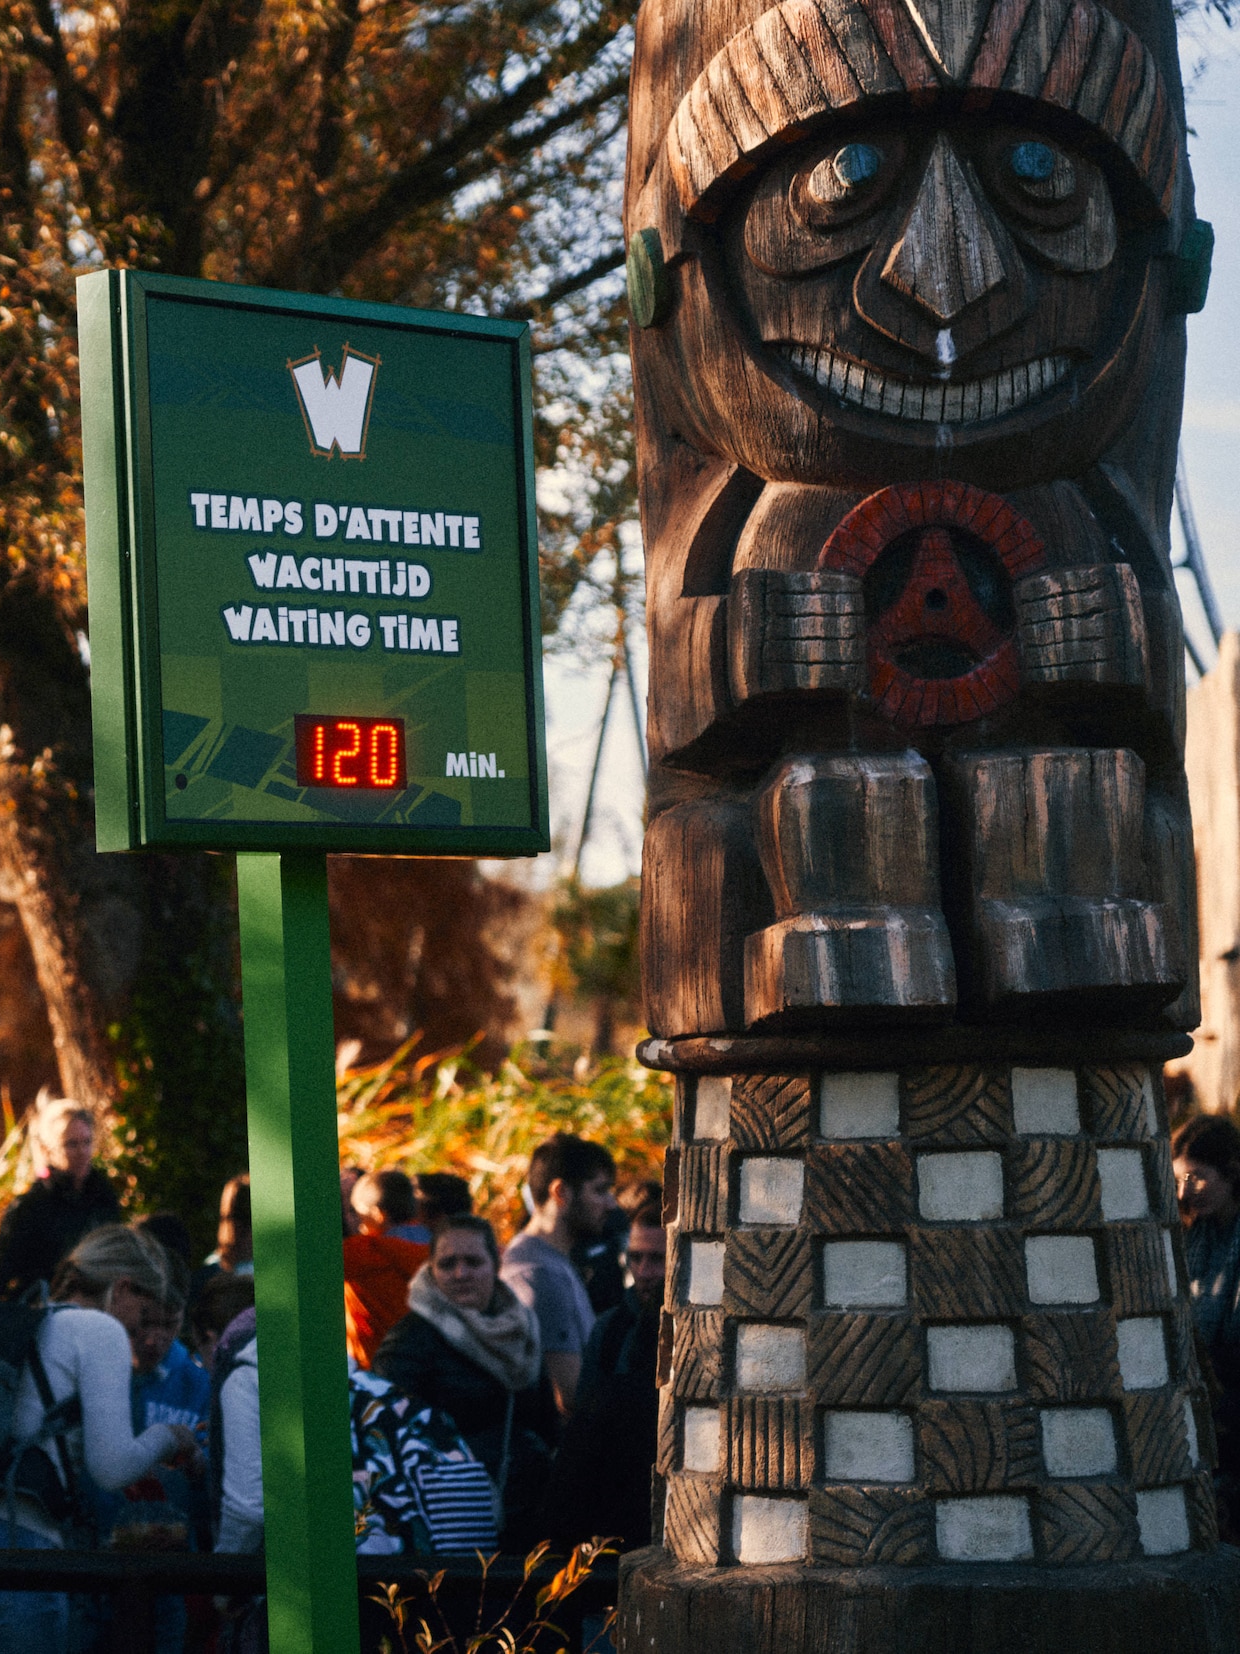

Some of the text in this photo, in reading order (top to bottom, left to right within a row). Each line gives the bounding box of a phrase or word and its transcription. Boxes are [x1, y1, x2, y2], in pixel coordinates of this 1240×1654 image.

[289, 348, 378, 457] W
[190, 492, 481, 549] TEMPS D'ATTENTE
[314, 722, 398, 786] 120
